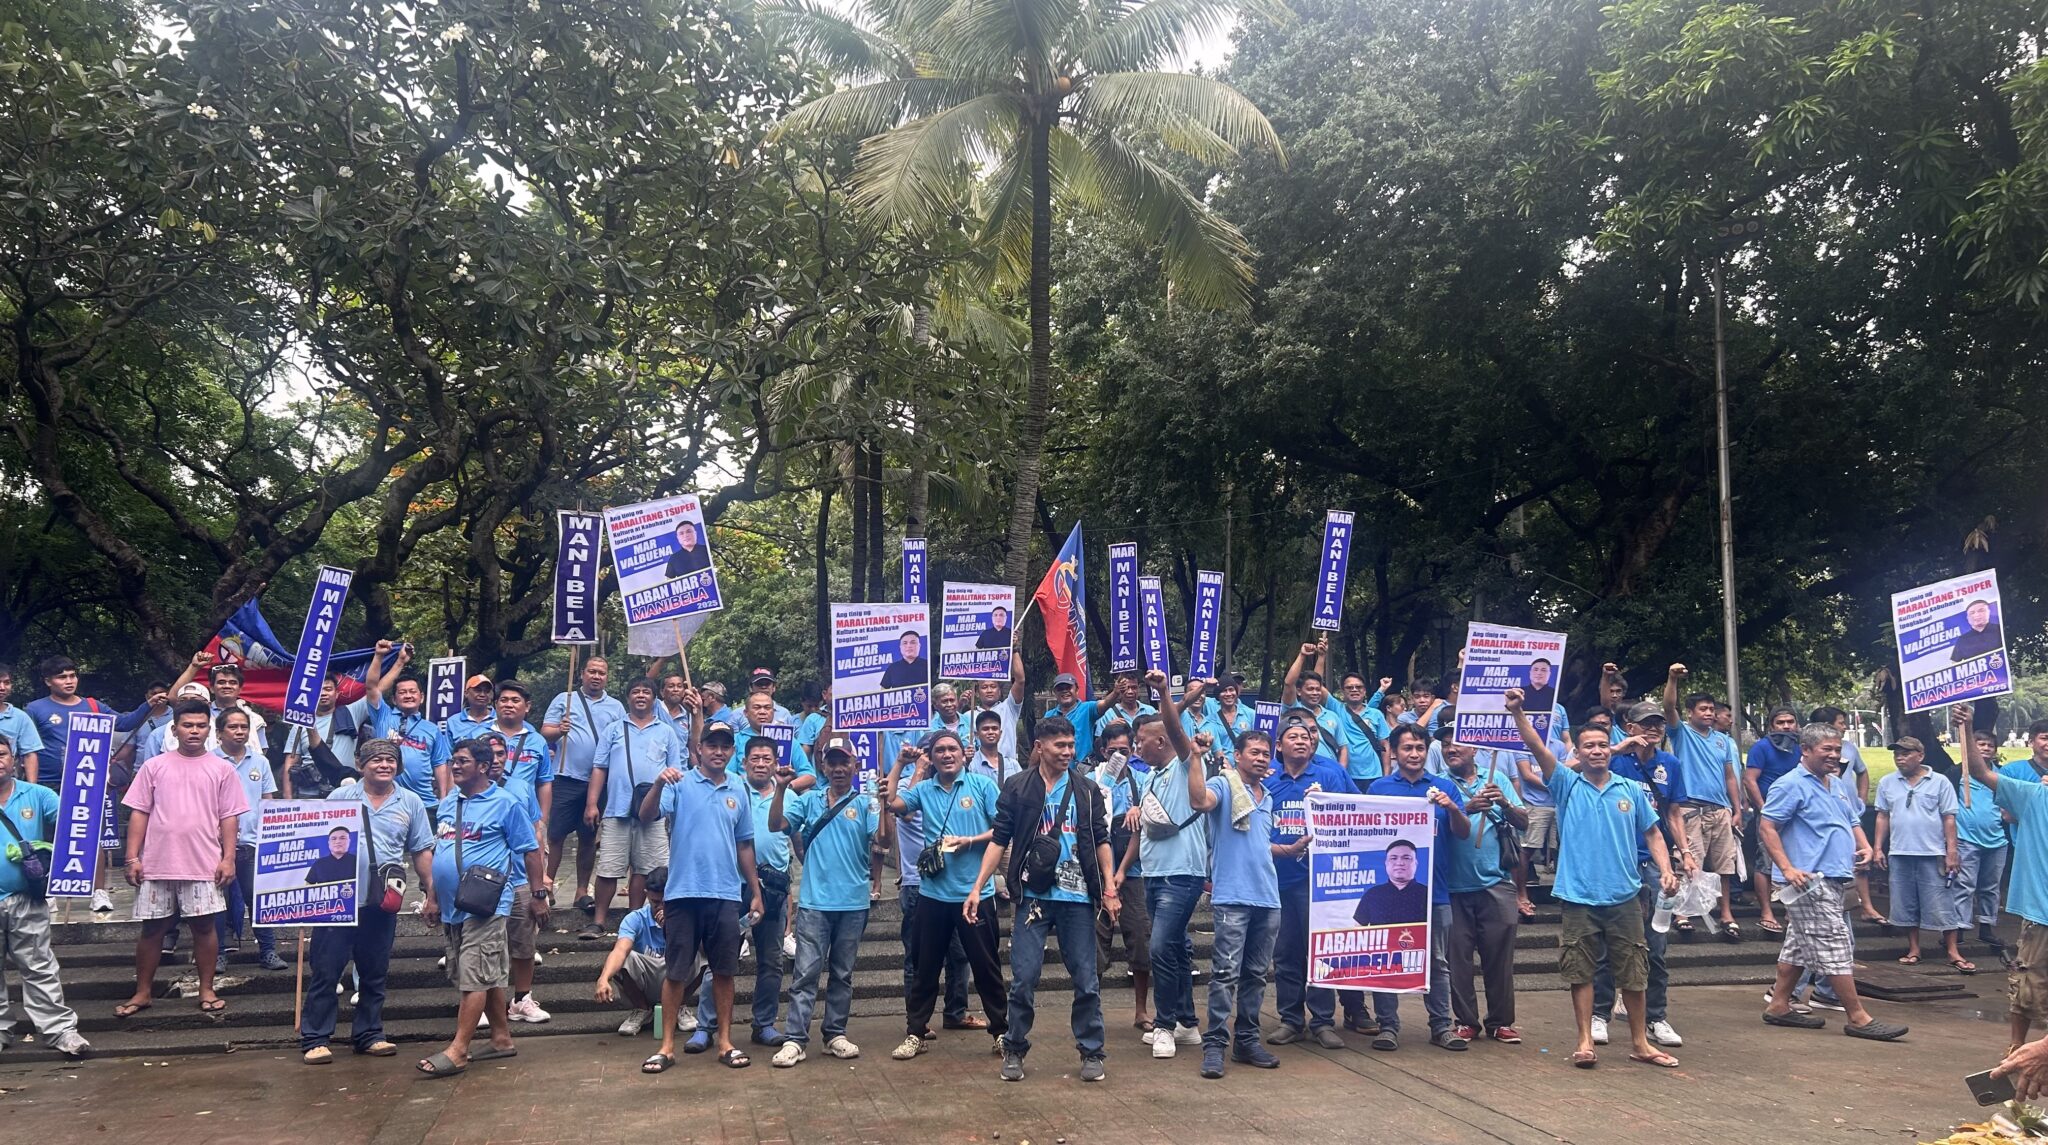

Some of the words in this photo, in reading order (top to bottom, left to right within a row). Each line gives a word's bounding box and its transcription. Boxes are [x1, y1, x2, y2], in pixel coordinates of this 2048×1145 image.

[611, 509, 663, 532] MARALITANG
[665, 503, 696, 516] TSUPER
[1329, 512, 1352, 524] MAR
[633, 539, 657, 553] MAR
[904, 541, 924, 550] MAR
[1112, 546, 1135, 559] MAR
[620, 545, 673, 570] VALBUENA
[321, 569, 349, 587] MAR
[564, 517, 592, 639] MANIBELA
[909, 554, 920, 603] MANIB
[1322, 527, 1346, 615] MANIBELA
[1140, 580, 1160, 589] MAR
[1200, 573, 1221, 585] MAR
[628, 585, 669, 608] LABAN
[671, 575, 699, 594] MAR
[1898, 592, 1954, 616] MARALITANG
[1955, 580, 1992, 596] TSUPER
[632, 587, 710, 622] MANIBELA
[697, 599, 718, 609] 2025
[1116, 562, 1130, 656] MANIBELA
[836, 616, 890, 628] MARALITANG
[893, 613, 925, 623] TSUPER
[958, 615, 976, 623] MAR
[1315, 617, 1338, 628] 2025
[946, 622, 986, 632] VALBUENA
[1146, 594, 1161, 670] MANIBE
[1197, 587, 1215, 673] MANIBELA
[1920, 621, 1944, 638] MAR
[294, 589, 340, 707] MANIBELA
[1471, 639, 1526, 649] MARALITANG
[1527, 642, 1560, 650] TSUPER
[1904, 626, 1961, 655] VALBUENA
[854, 644, 878, 657] MAR
[945, 651, 974, 664] LABAN
[976, 650, 998, 660] MAR
[837, 653, 893, 670] VALBUENA
[944, 661, 1002, 676] MANIBELA
[1113, 659, 1136, 670] 2025
[1484, 667, 1509, 676] MAR
[1910, 667, 1954, 694] LABAN
[1956, 658, 1988, 679] MAR
[1466, 677, 1521, 687] VALBUENA
[1911, 670, 1998, 708] MANIBELA
[1982, 683, 2007, 694] 2025
[839, 695, 880, 713] LABAN
[883, 690, 912, 706] MAR
[286, 708, 314, 724] 2025
[839, 703, 919, 728] MANIBELA
[1257, 704, 1280, 716] MAR
[72, 717, 111, 733] MAR
[1461, 715, 1499, 728] LABAN
[764, 727, 792, 740] MAR
[1459, 729, 1524, 742] MANIBE
[63, 738, 100, 873] MANIBELA
[1327, 803, 1344, 811] tinig
[1346, 803, 1356, 811] ng
[263, 812, 320, 824] MARALITANG
[323, 809, 356, 819] TSUPER
[1312, 813, 1381, 826] MARALITANG
[1384, 812, 1428, 825] TSUPER
[1288, 827, 1305, 835] 2025
[1349, 827, 1398, 836] Hanapbuhay
[279, 840, 305, 853] MAR
[261, 849, 320, 866] VALBUENA
[1332, 855, 1359, 871] MAR
[51, 879, 91, 892] 2025
[1316, 869, 1376, 887] VALBUENA
[260, 889, 304, 909] LABAN
[308, 885, 338, 902] MAR
[260, 899, 346, 923] MANIBELA
[1315, 929, 1389, 955] LABAN!!!
[1313, 950, 1425, 981] MANIBELA!!!
